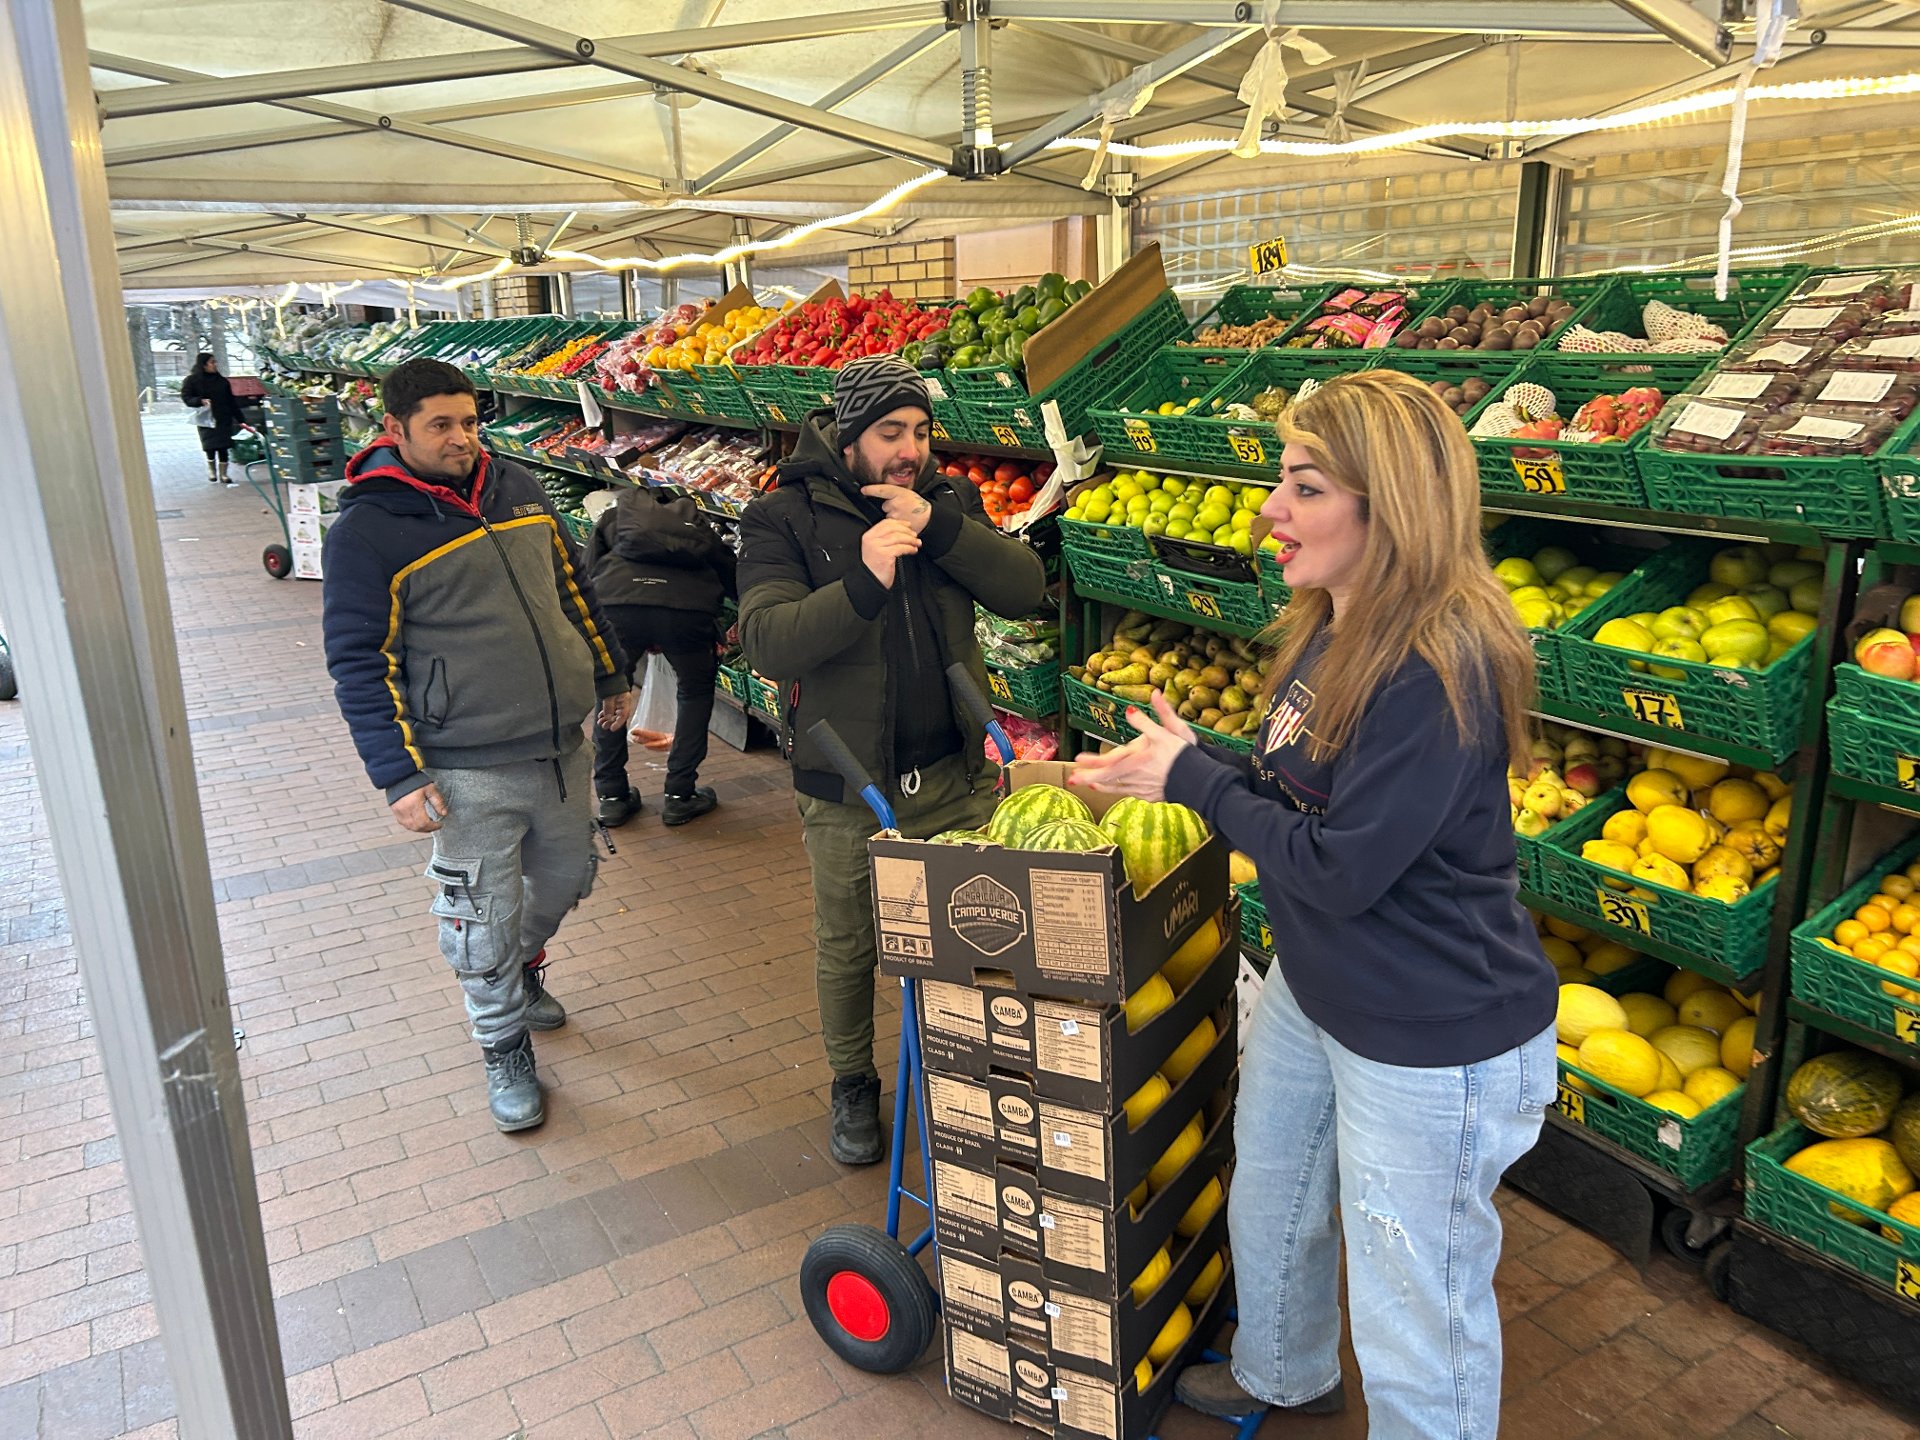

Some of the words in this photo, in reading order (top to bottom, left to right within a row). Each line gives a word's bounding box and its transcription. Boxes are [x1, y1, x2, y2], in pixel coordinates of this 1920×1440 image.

[1524, 467, 1557, 494] 59
[954, 906, 987, 918] CAMPO
[989, 907, 1020, 924] VERDE
[883, 954, 908, 964] PRODUCT
[916, 958, 934, 967] BRAZIL
[994, 1005, 1022, 1019] SAMBA
[926, 1034, 948, 1046] PRODUCE
[956, 1043, 973, 1053] BRAZIL
[1001, 1103, 1029, 1118] SAMBA
[1005, 1193, 1031, 1211] SAMBA
[1011, 1287, 1039, 1304] SAMBA
[1018, 1364, 1044, 1383] SAMBA
